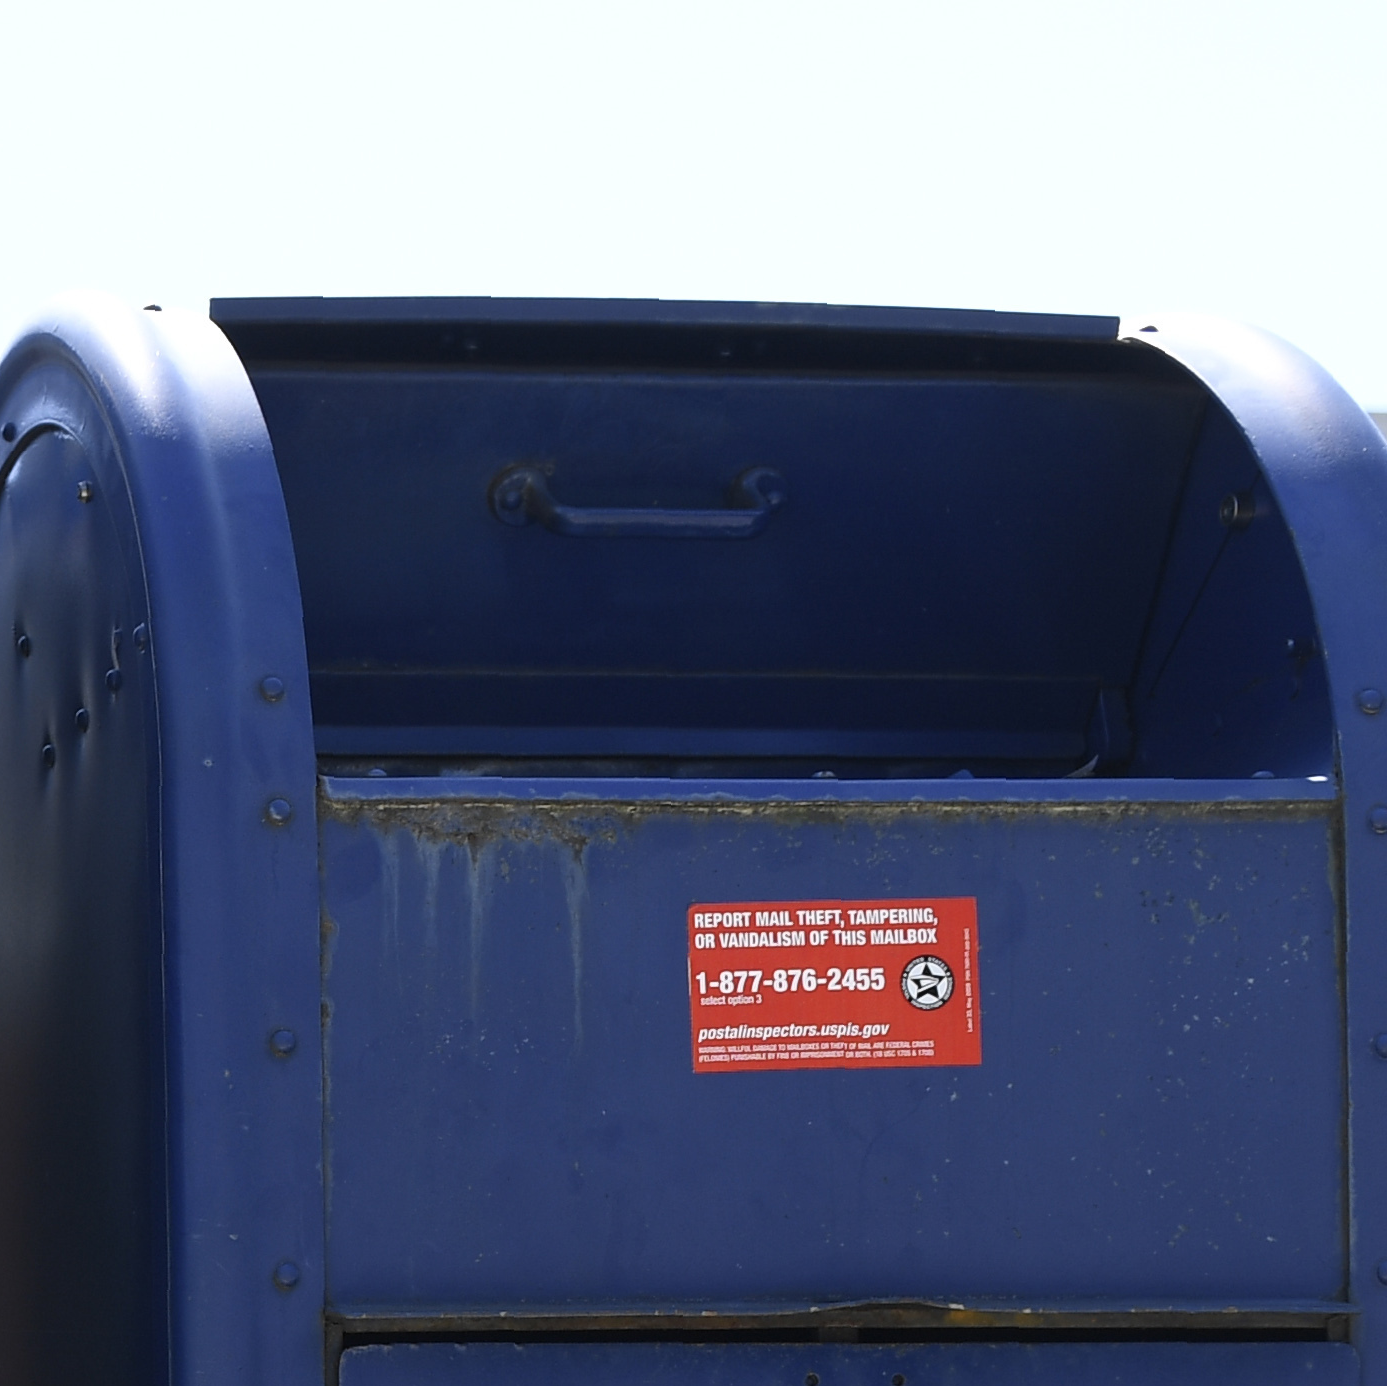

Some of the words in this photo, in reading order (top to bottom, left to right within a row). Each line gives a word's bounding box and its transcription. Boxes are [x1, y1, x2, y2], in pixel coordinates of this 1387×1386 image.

[695, 912, 751, 928] REPORT
[756, 911, 793, 926] MAIL
[796, 910, 844, 928] THEFT,
[848, 908, 937, 925] TAMPERING,
[695, 934, 715, 948] OR
[719, 931, 805, 948] VANDALISM
[810, 930, 828, 945] OF
[832, 930, 866, 945] THIS
[871, 928, 937, 944] MAILBOX
[696, 968, 884, 994] 1-877-876-2455
[700, 995, 726, 1005] select
[728, 995, 754, 1006] option
[756, 994, 762, 1004] 3
[698, 1023, 889, 1042] postalinspectors.uspis.gov
